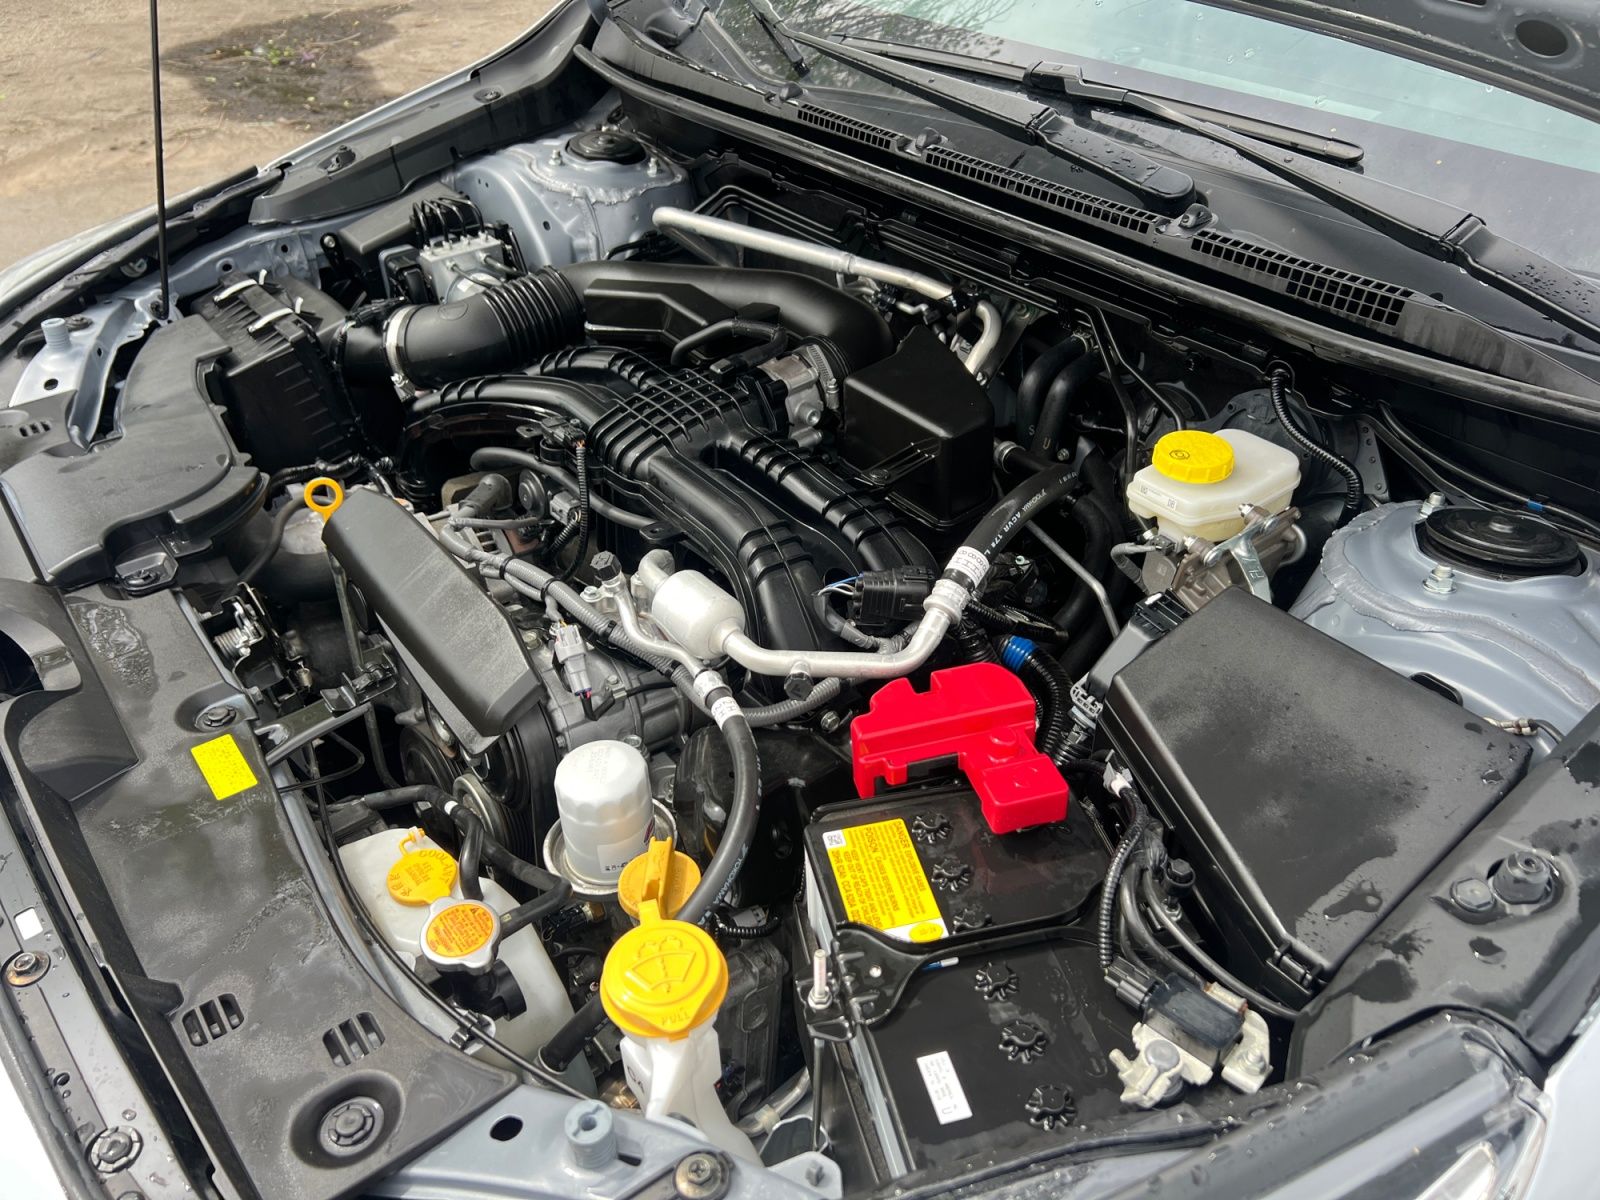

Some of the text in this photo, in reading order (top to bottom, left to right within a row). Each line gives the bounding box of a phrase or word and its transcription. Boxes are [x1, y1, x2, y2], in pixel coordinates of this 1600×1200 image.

[862, 826, 880, 853] POISON
[892, 821, 910, 848] DANGER
[713, 856, 744, 905] YOKOHAMA
